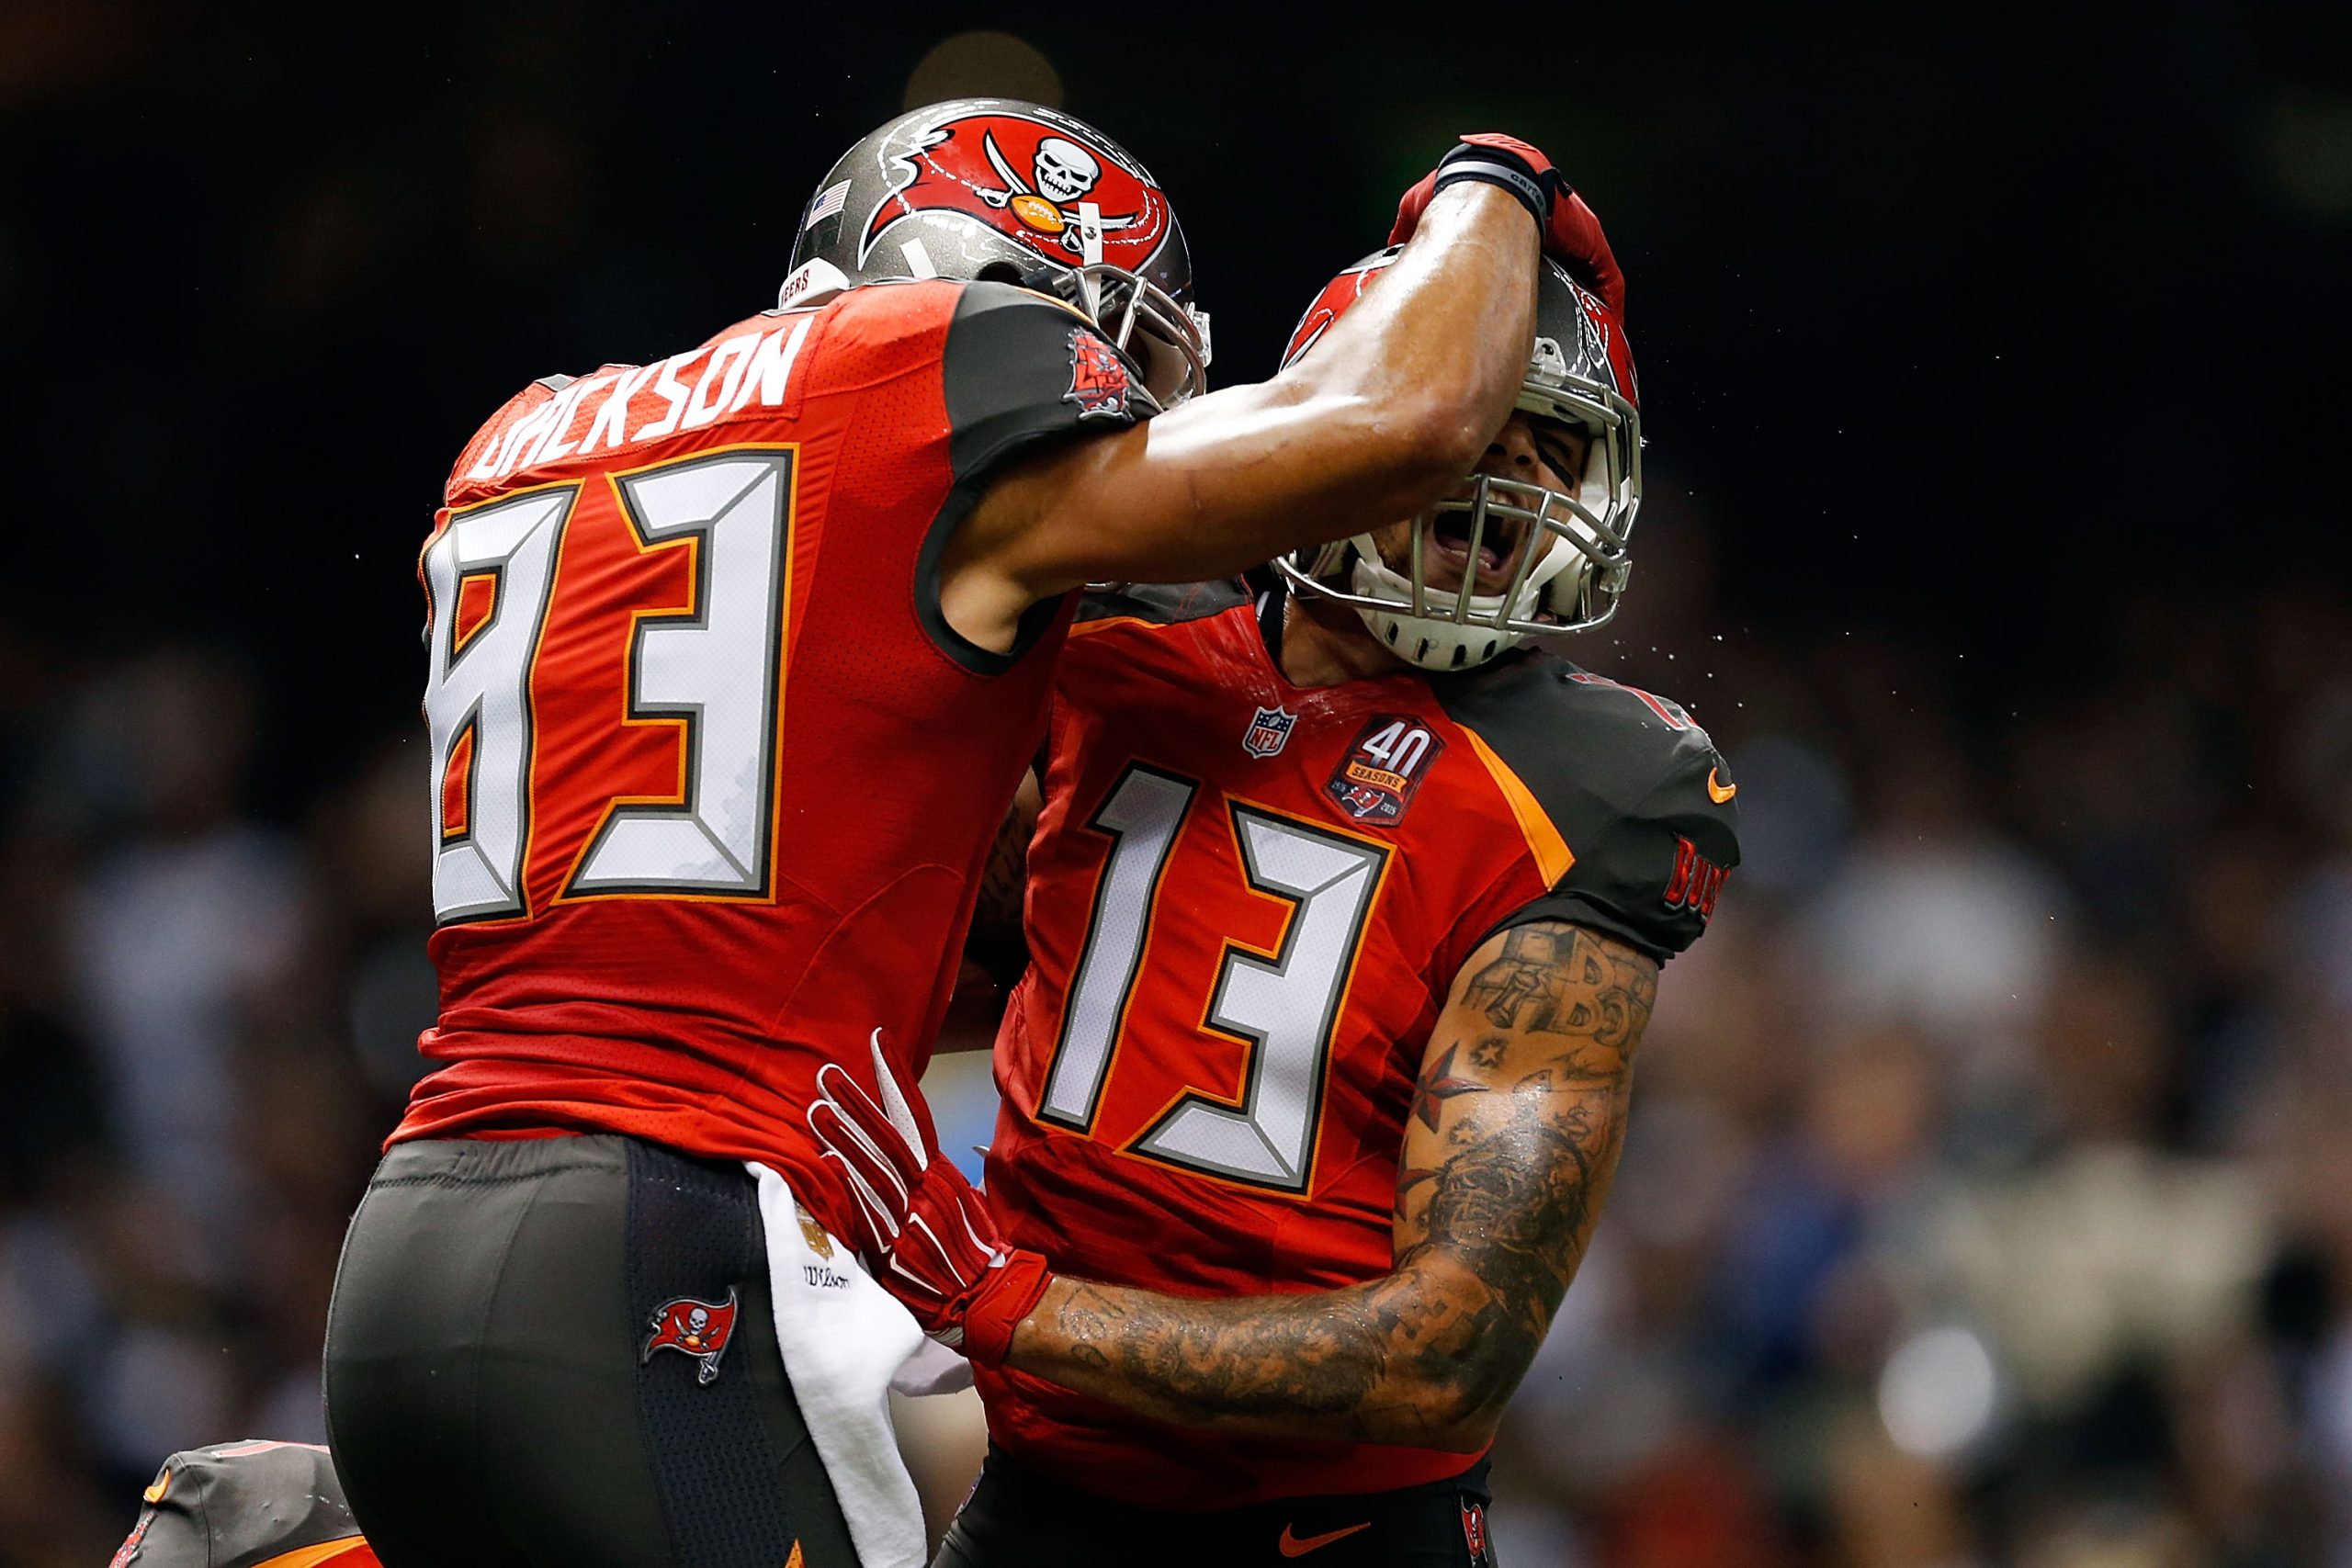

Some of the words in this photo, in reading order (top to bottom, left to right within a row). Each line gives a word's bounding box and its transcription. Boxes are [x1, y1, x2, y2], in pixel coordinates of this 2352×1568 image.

[781, 268, 809, 305] EERS
[466, 315, 814, 479] JACKSON
[418, 442, 799, 924] 83
[1250, 728, 1281, 750] NFL
[1363, 721, 1430, 778] 40
[1351, 766, 1400, 787] SEASONS
[1380, 802, 1396, 816] 2015
[1031, 754, 1397, 1201] 13
[803, 1266, 850, 1288] Wilson
